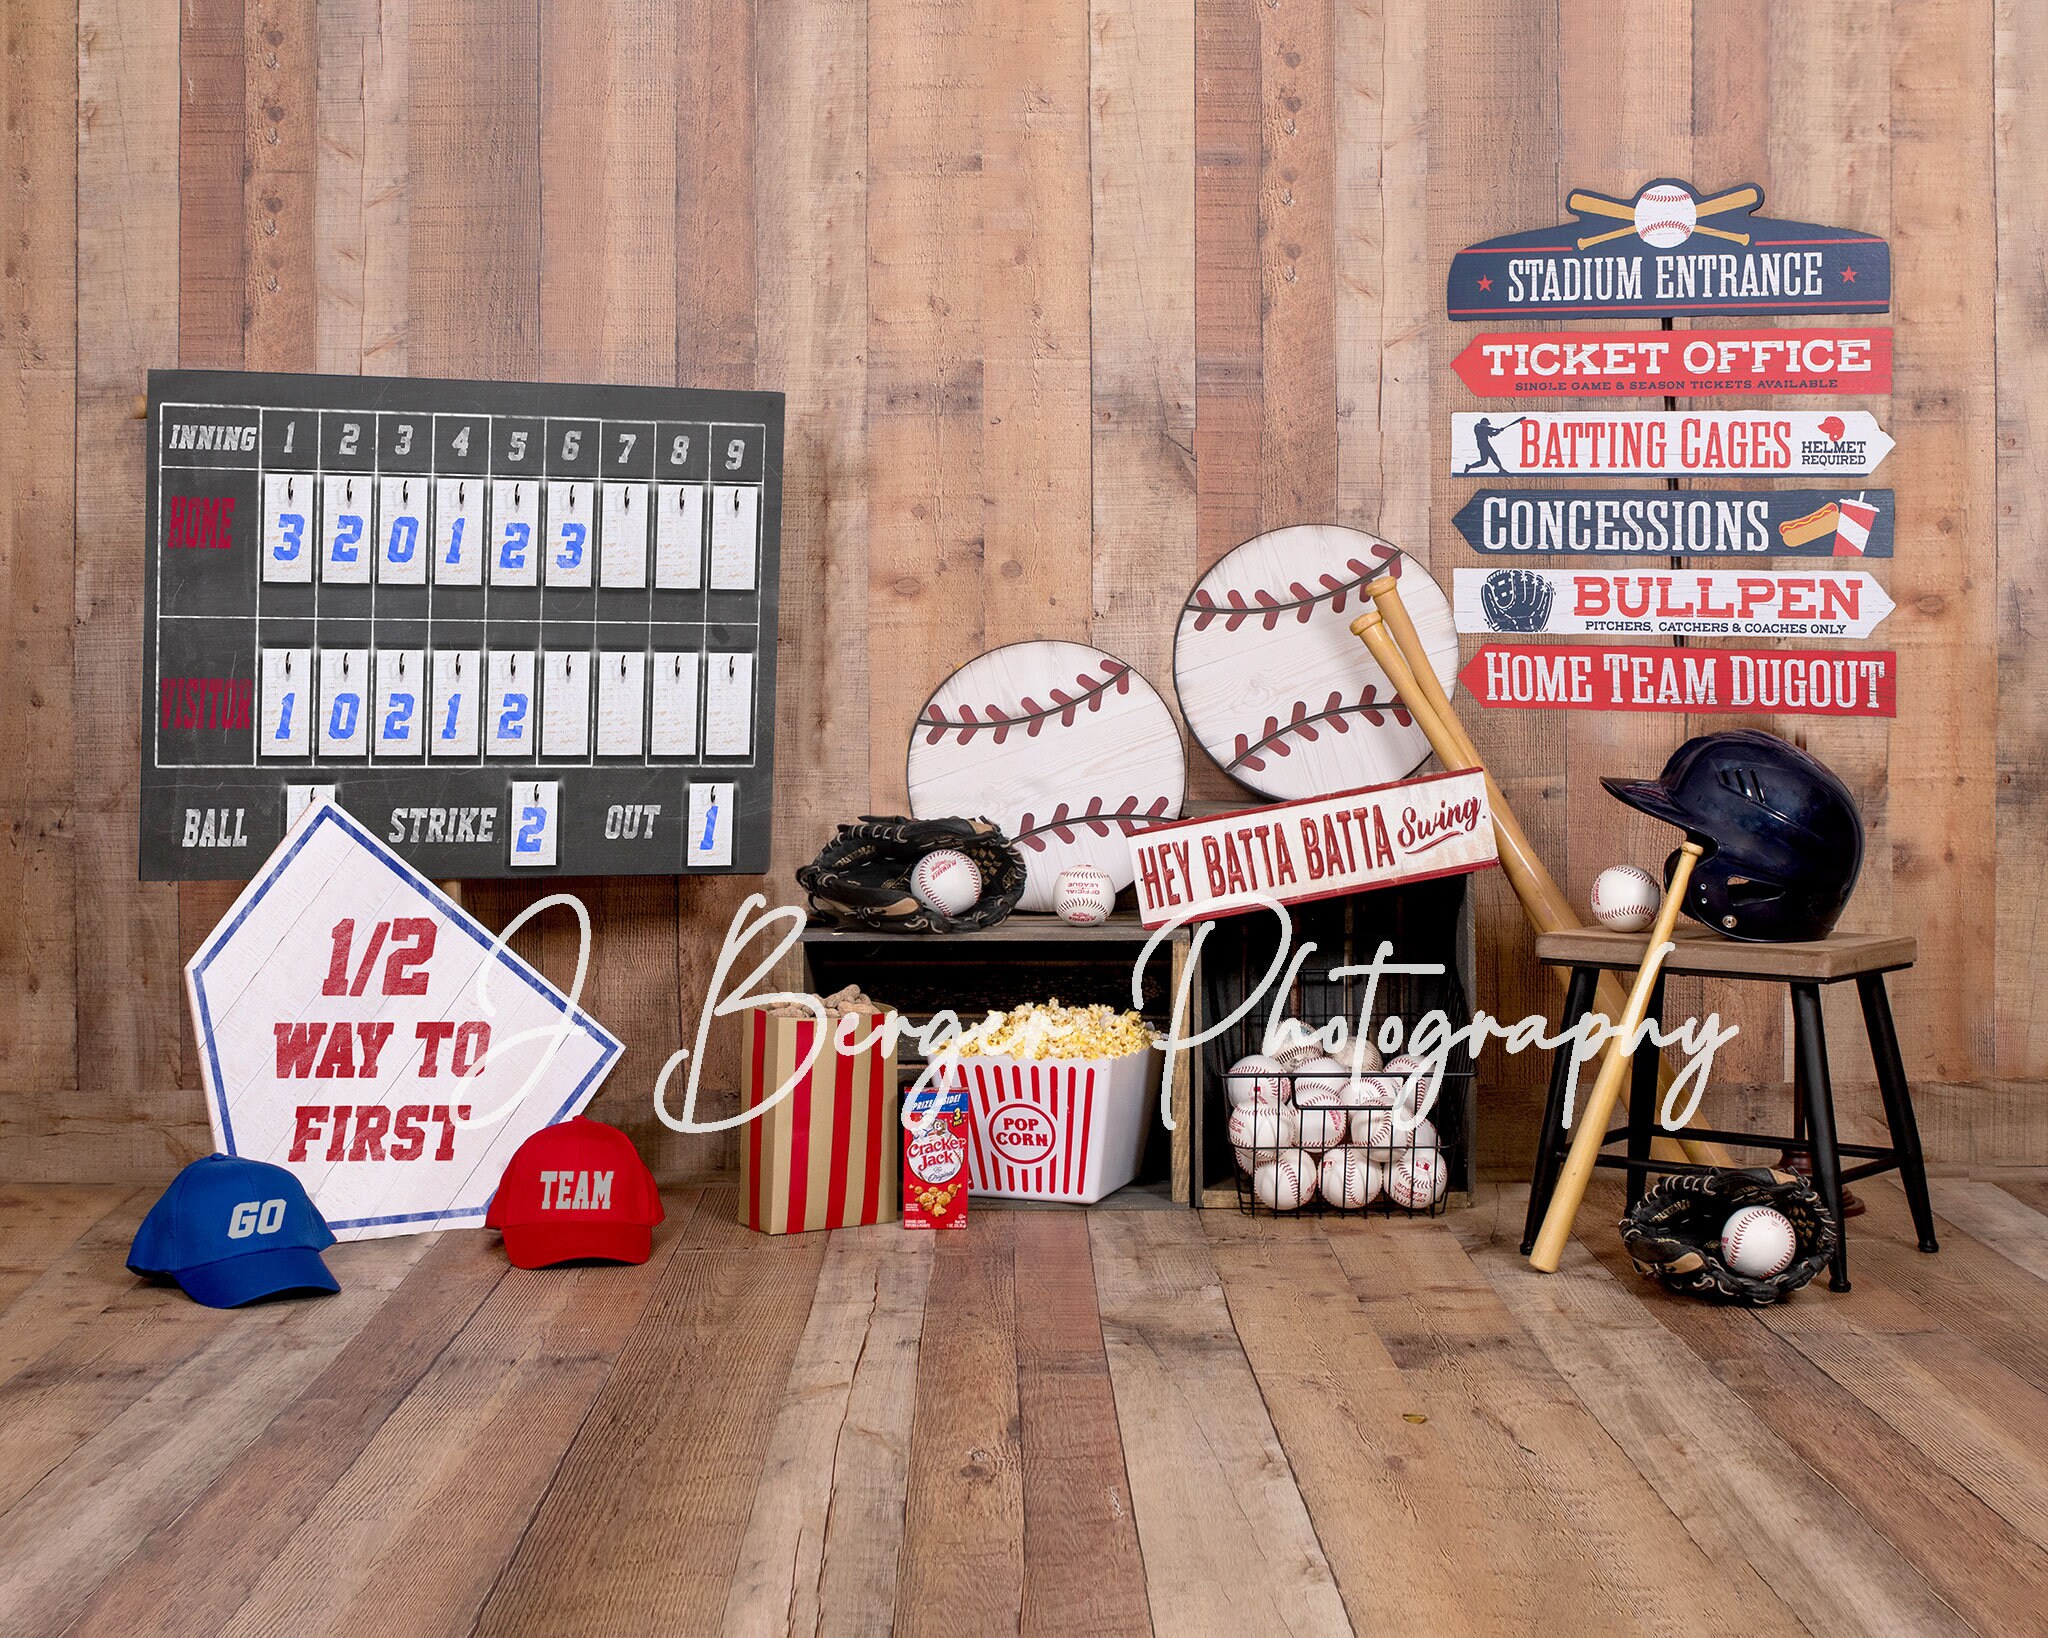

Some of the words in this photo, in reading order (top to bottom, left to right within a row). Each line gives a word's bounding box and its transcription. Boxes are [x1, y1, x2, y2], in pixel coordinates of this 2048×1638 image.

[1508, 256, 1643, 302] STADIUM
[1655, 252, 1823, 299] ENTRANCE
[1482, 341, 1669, 376] TICKET
[1683, 339, 1872, 374] OFFICE
[1515, 382, 1567, 391] SINGLE
[1570, 381, 1613, 391] GAME
[1616, 381, 1624, 390] &
[1629, 380, 1686, 390] SEASON
[1690, 380, 1752, 389] TICKETS
[1757, 379, 1838, 389] AVAILABLE
[169, 424, 257, 452] INNING
[283, 421, 295, 454] 1
[339, 423, 361, 455] 2
[395, 424, 413, 455] 3
[452, 426, 471, 457] 4
[508, 431, 528, 461] 5
[562, 431, 582, 461] 6
[618, 434, 637, 463] 7
[670, 435, 690, 465] 8
[726, 439, 746, 470] 9
[1519, 418, 1666, 468] BATTING
[1680, 418, 1791, 469] CAGES
[1801, 440, 1866, 453] HELMET
[1801, 453, 1866, 466] REQUIRED
[167, 496, 236, 550] HOME
[273, 513, 305, 561] 3
[331, 515, 364, 562] 2
[387, 516, 419, 562] 0
[445, 517, 466, 564] 1
[499, 522, 531, 569] 2
[556, 523, 587, 569] 3
[1483, 497, 1769, 552] CONCESSIONS
[1573, 576, 1862, 621] BULLPEN
[1585, 620, 1654, 632] PITCHERS,
[1658, 621, 1729, 632] CATCHERS
[1732, 621, 1741, 632] &
[1744, 622, 1808, 633] COACHES
[1810, 623, 1847, 635] ONLY
[1484, 651, 1592, 702] HOME
[1604, 653, 1717, 705] TEAM
[1730, 655, 1885, 709] DUGOUT
[161, 677, 253, 731] VISITOR
[275, 693, 296, 740] 1
[328, 693, 361, 741] 0
[383, 693, 415, 740] 2
[441, 693, 461, 740] 1
[497, 693, 528, 740] 2
[182, 807, 248, 849] BALL
[388, 807, 498, 844] STRIKE
[515, 807, 548, 854] 2
[604, 804, 661, 841] OUT
[699, 805, 718, 852] 1
[1138, 839, 1194, 910] HEY
[1201, 822, 1297, 898] BATTA
[1300, 804, 1396, 880] BATTA
[1397, 796, 1482, 849] Swing
[322, 917, 438, 996] 1/2
[273, 1022, 394, 1079] WAY
[415, 1021, 492, 1079] TO
[288, 1104, 471, 1162] FIRST
[954, 1108, 961, 1120] 3
[1003, 1118, 1039, 1131] POP
[908, 1137, 967, 1157] Cracker
[918, 1151, 954, 1171] Jack
[995, 1132, 1048, 1147] CORN
[540, 1170, 614, 1211] TEAM
[227, 1199, 287, 1240] GO
